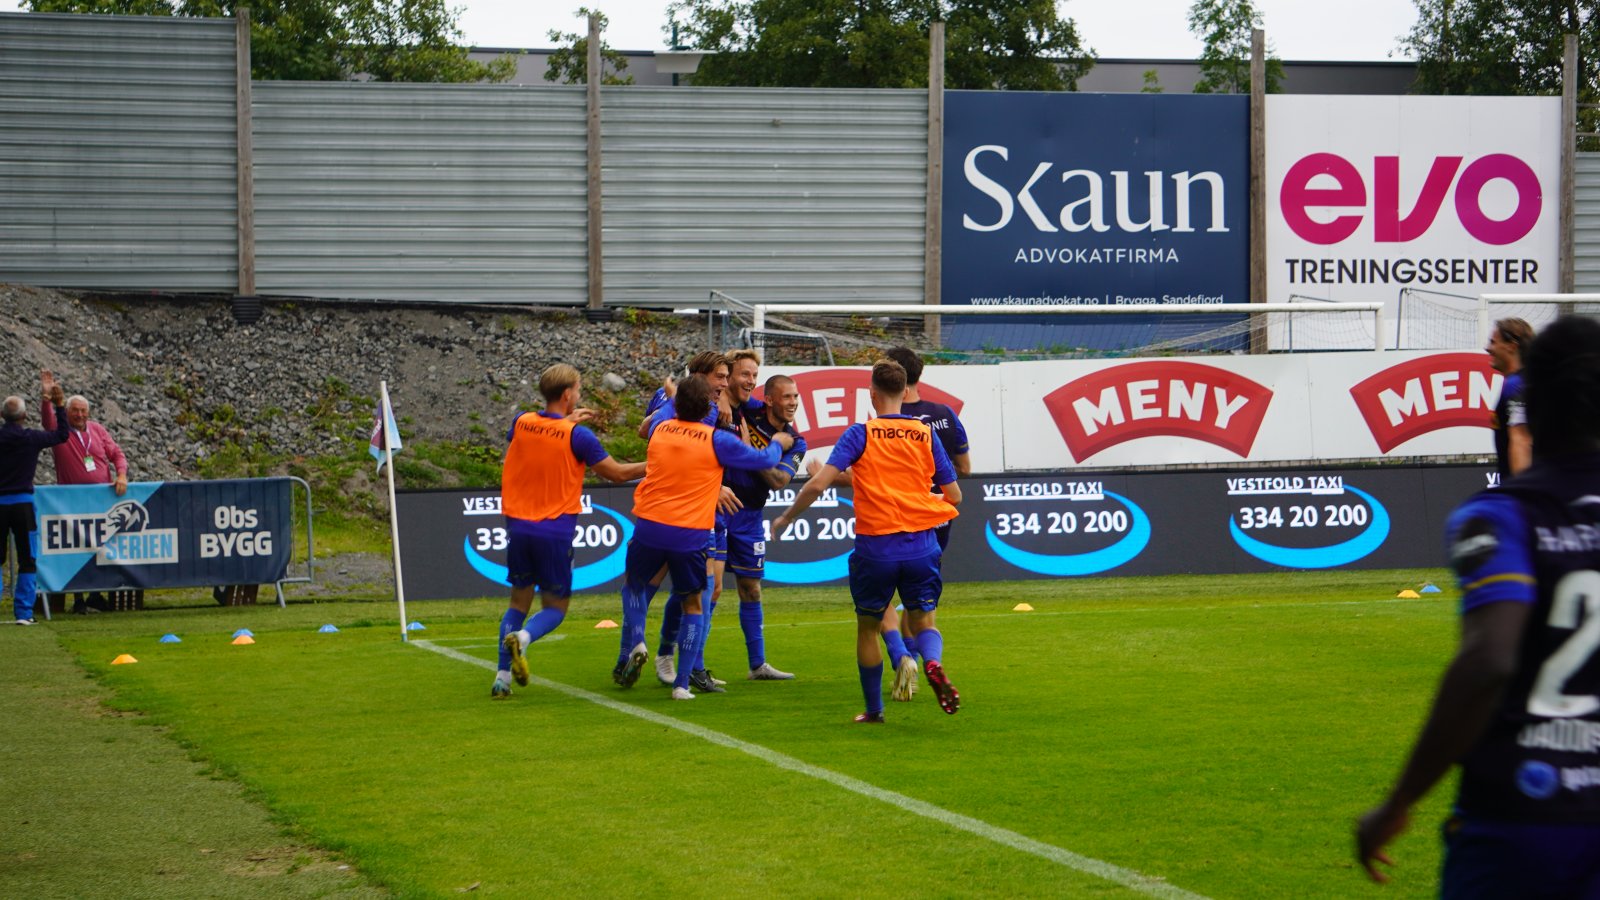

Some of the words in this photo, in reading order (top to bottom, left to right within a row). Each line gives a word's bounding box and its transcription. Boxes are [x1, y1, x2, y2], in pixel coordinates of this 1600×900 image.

[963, 144, 1230, 232] Skaun
[1280, 152, 1542, 246] evo
[1014, 248, 1179, 263] ADVOKATFIRMA
[1285, 258, 1538, 283] TRENINGSSENTER
[971, 293, 1099, 305] www.skaunadvokat.no
[1162, 294, 1224, 305] Sandefjord
[1072, 379, 1249, 437] MENY
[1378, 371, 1504, 427] MEN
[516, 420, 566, 440] macron
[657, 424, 707, 442] macron
[871, 427, 929, 442] macron
[983, 482, 1063, 498] VESTFOLD
[1069, 481, 1103, 495] TAXI
[1227, 477, 1304, 491] VESTFOLD
[1308, 476, 1343, 490] TAXI
[996, 513, 1041, 535] 334
[1047, 512, 1077, 534] 20
[1083, 510, 1128, 533] 200
[1240, 507, 1284, 529] 334
[1289, 505, 1318, 528] 20
[1324, 504, 1367, 527] 200
[47, 518, 107, 549] ELITE
[200, 531, 273, 558] BYGG
[476, 528, 511, 551] 33
[572, 524, 618, 548] 200
[104, 533, 172, 561] SERIEN
